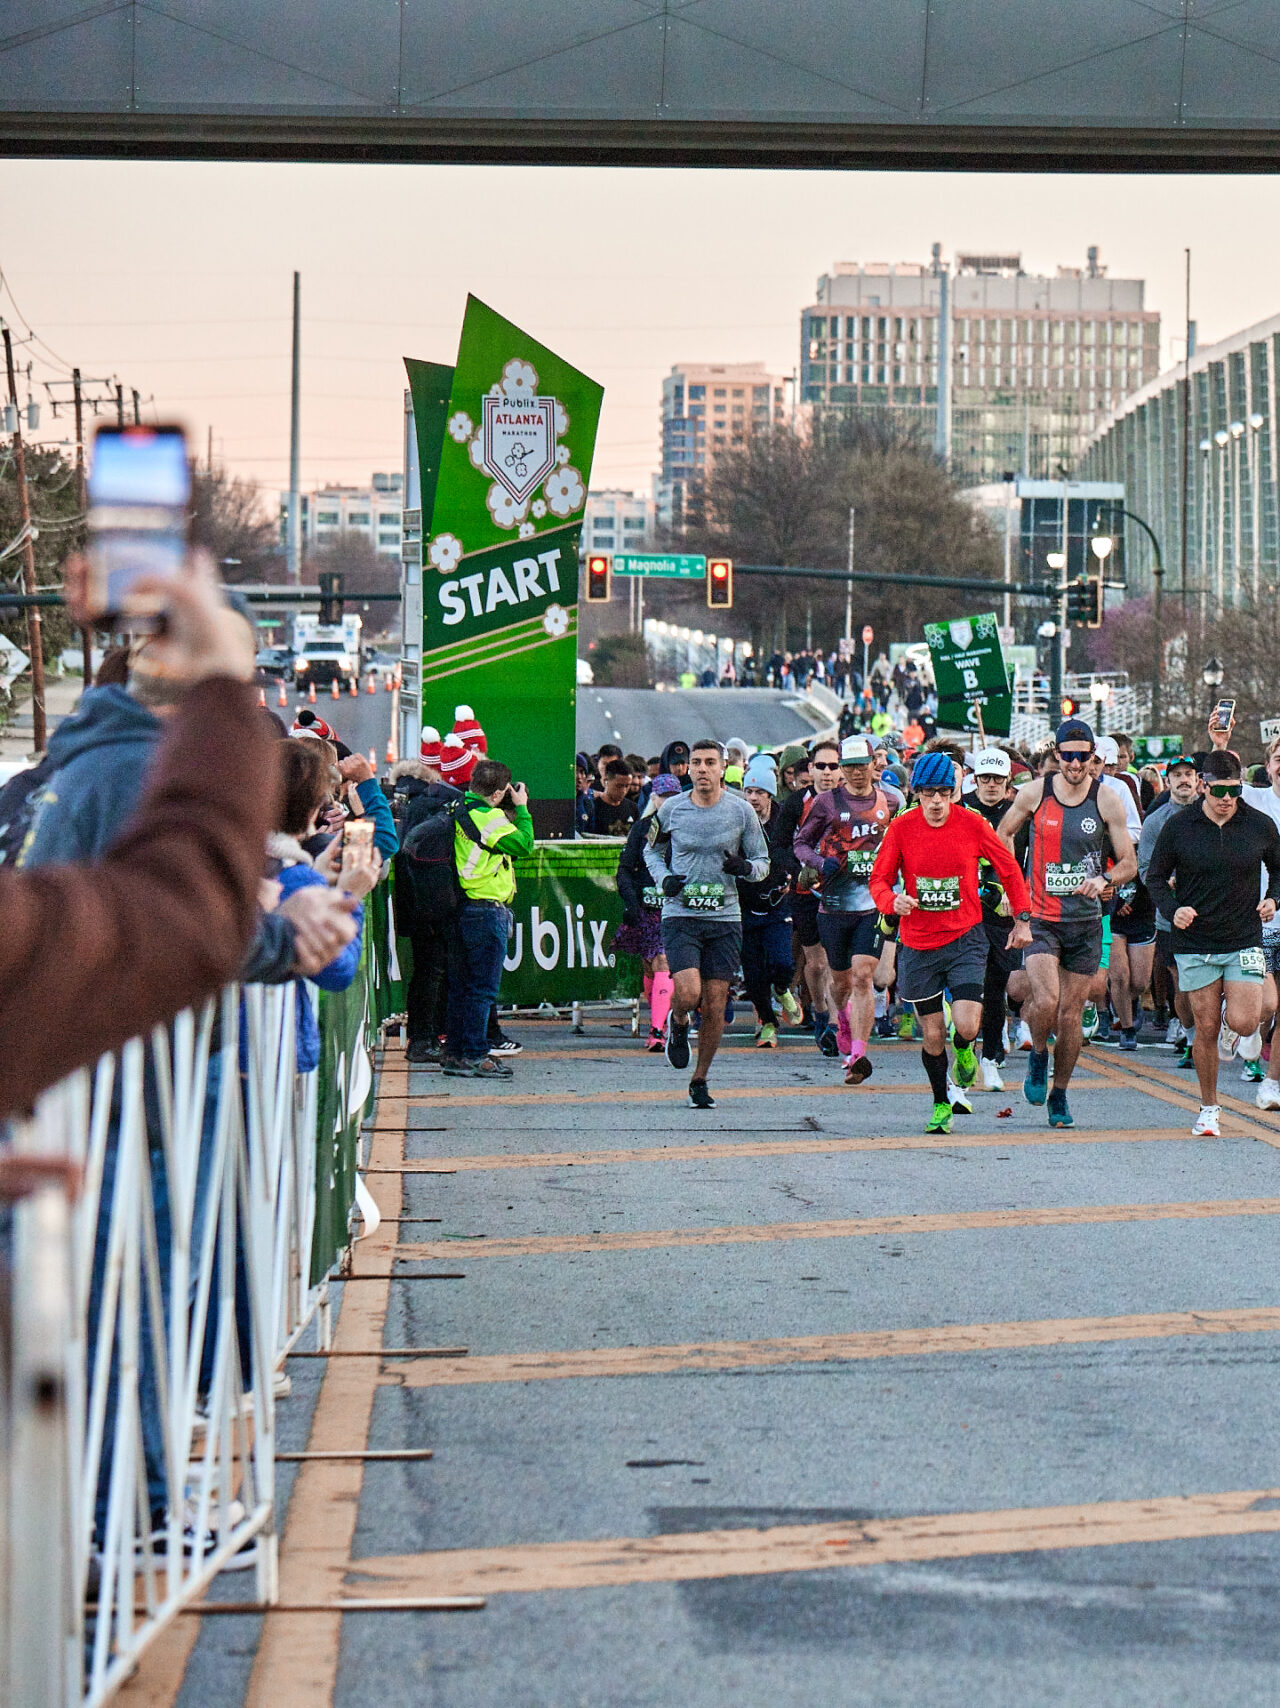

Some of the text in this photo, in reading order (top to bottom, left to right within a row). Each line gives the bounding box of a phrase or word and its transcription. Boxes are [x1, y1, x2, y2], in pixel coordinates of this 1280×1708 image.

[503, 398, 535, 408] Publix
[496, 414, 544, 425] ATLANTA
[628, 559, 676, 575] Magnolia
[438, 548, 561, 625] START
[954, 657, 981, 670] WAVE
[963, 670, 979, 689] B
[980, 757, 1005, 767] ciele
[851, 821, 879, 839] ARC
[852, 863, 874, 873] A50
[688, 898, 720, 907] A746
[921, 892, 954, 902] A445
[503, 904, 609, 972] ublix
